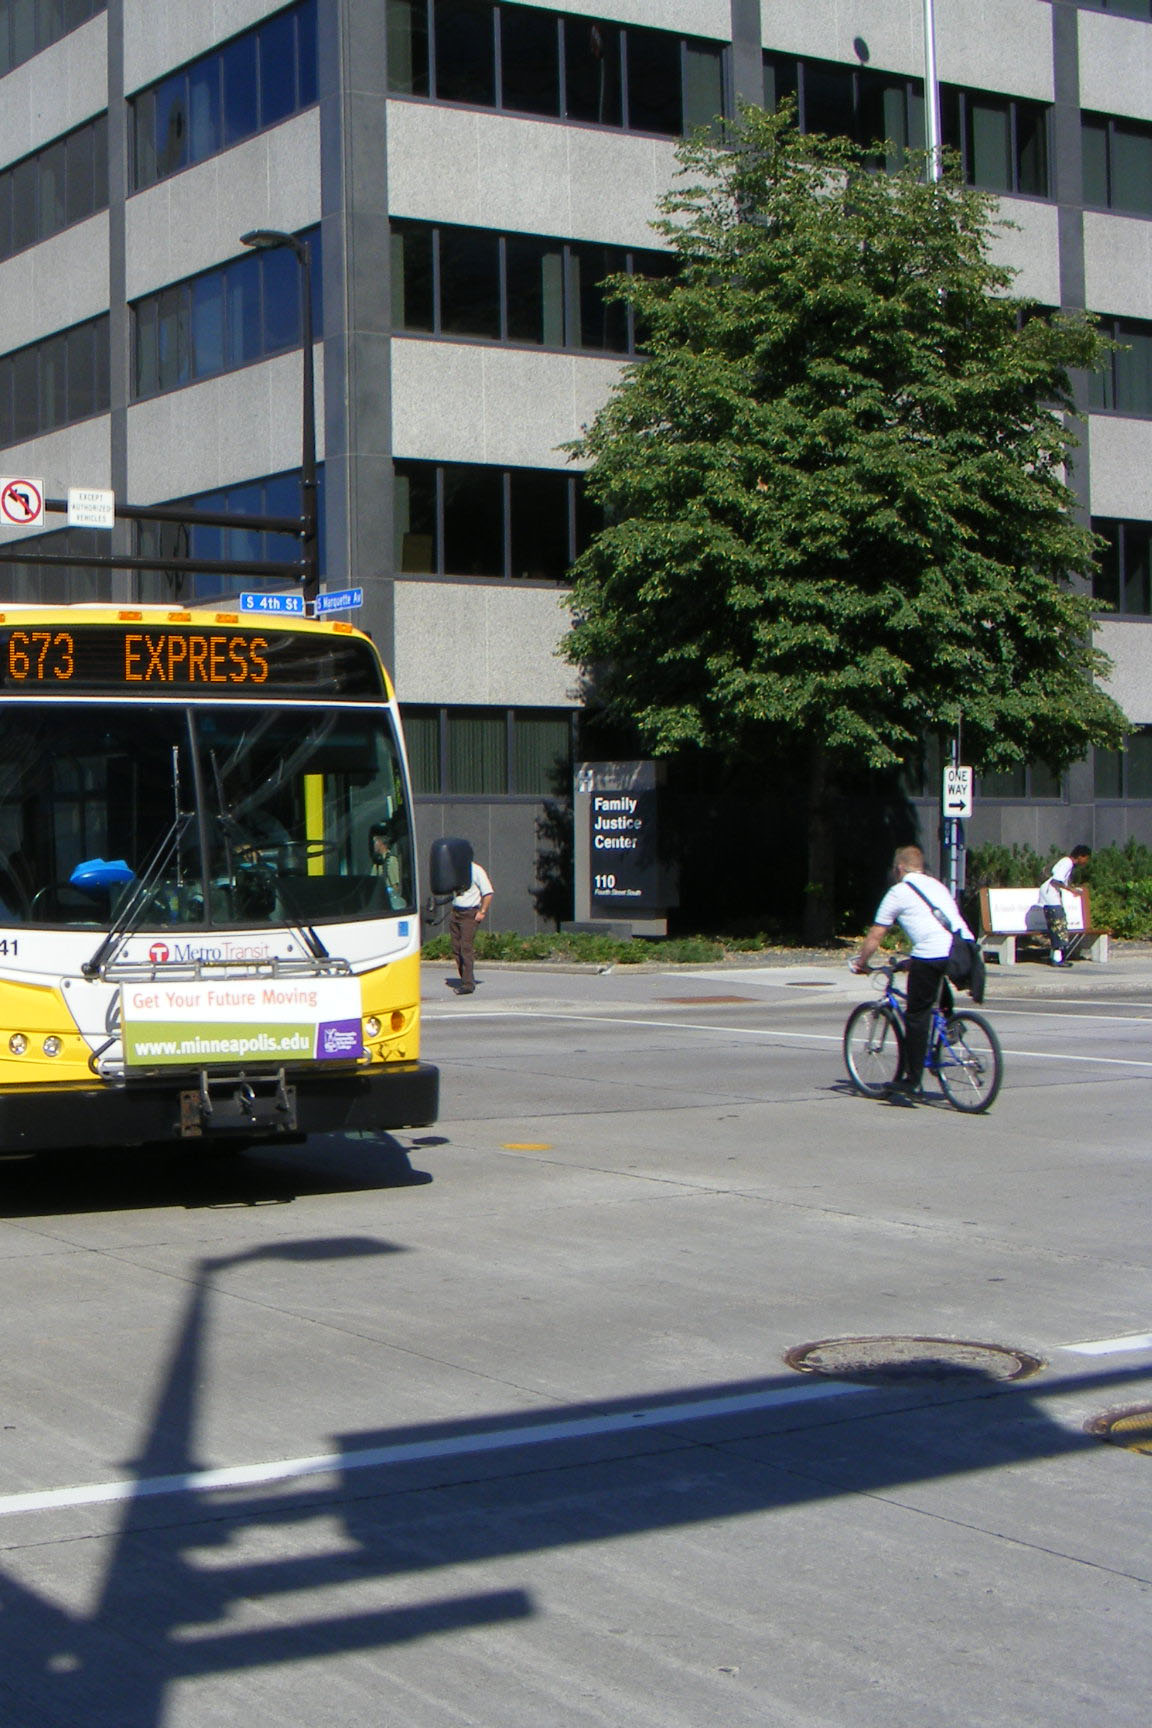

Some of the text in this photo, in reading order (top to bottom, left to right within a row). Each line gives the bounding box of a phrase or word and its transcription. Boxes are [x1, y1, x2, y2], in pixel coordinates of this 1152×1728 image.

[72, 504, 111, 512] AUTHORIZED
[77, 514, 106, 522] VEHICLES
[246, 596, 298, 611] S 4th St
[323, 595, 351, 609] Marquette
[8, 631, 269, 683] 673 EXPRESS
[948, 770, 968, 782] ONE
[948, 784, 968, 796] WAY
[595, 797, 637, 813] Family
[594, 815, 642, 830] Justice
[594, 834, 638, 849] Center
[594, 874, 616, 889] 110
[174, 944, 222, 961] Metro
[222, 942, 269, 959] Transit
[133, 988, 317, 1008] Get Your Future Moving
[134, 1032, 310, 1056] www.minneapolis.edu
